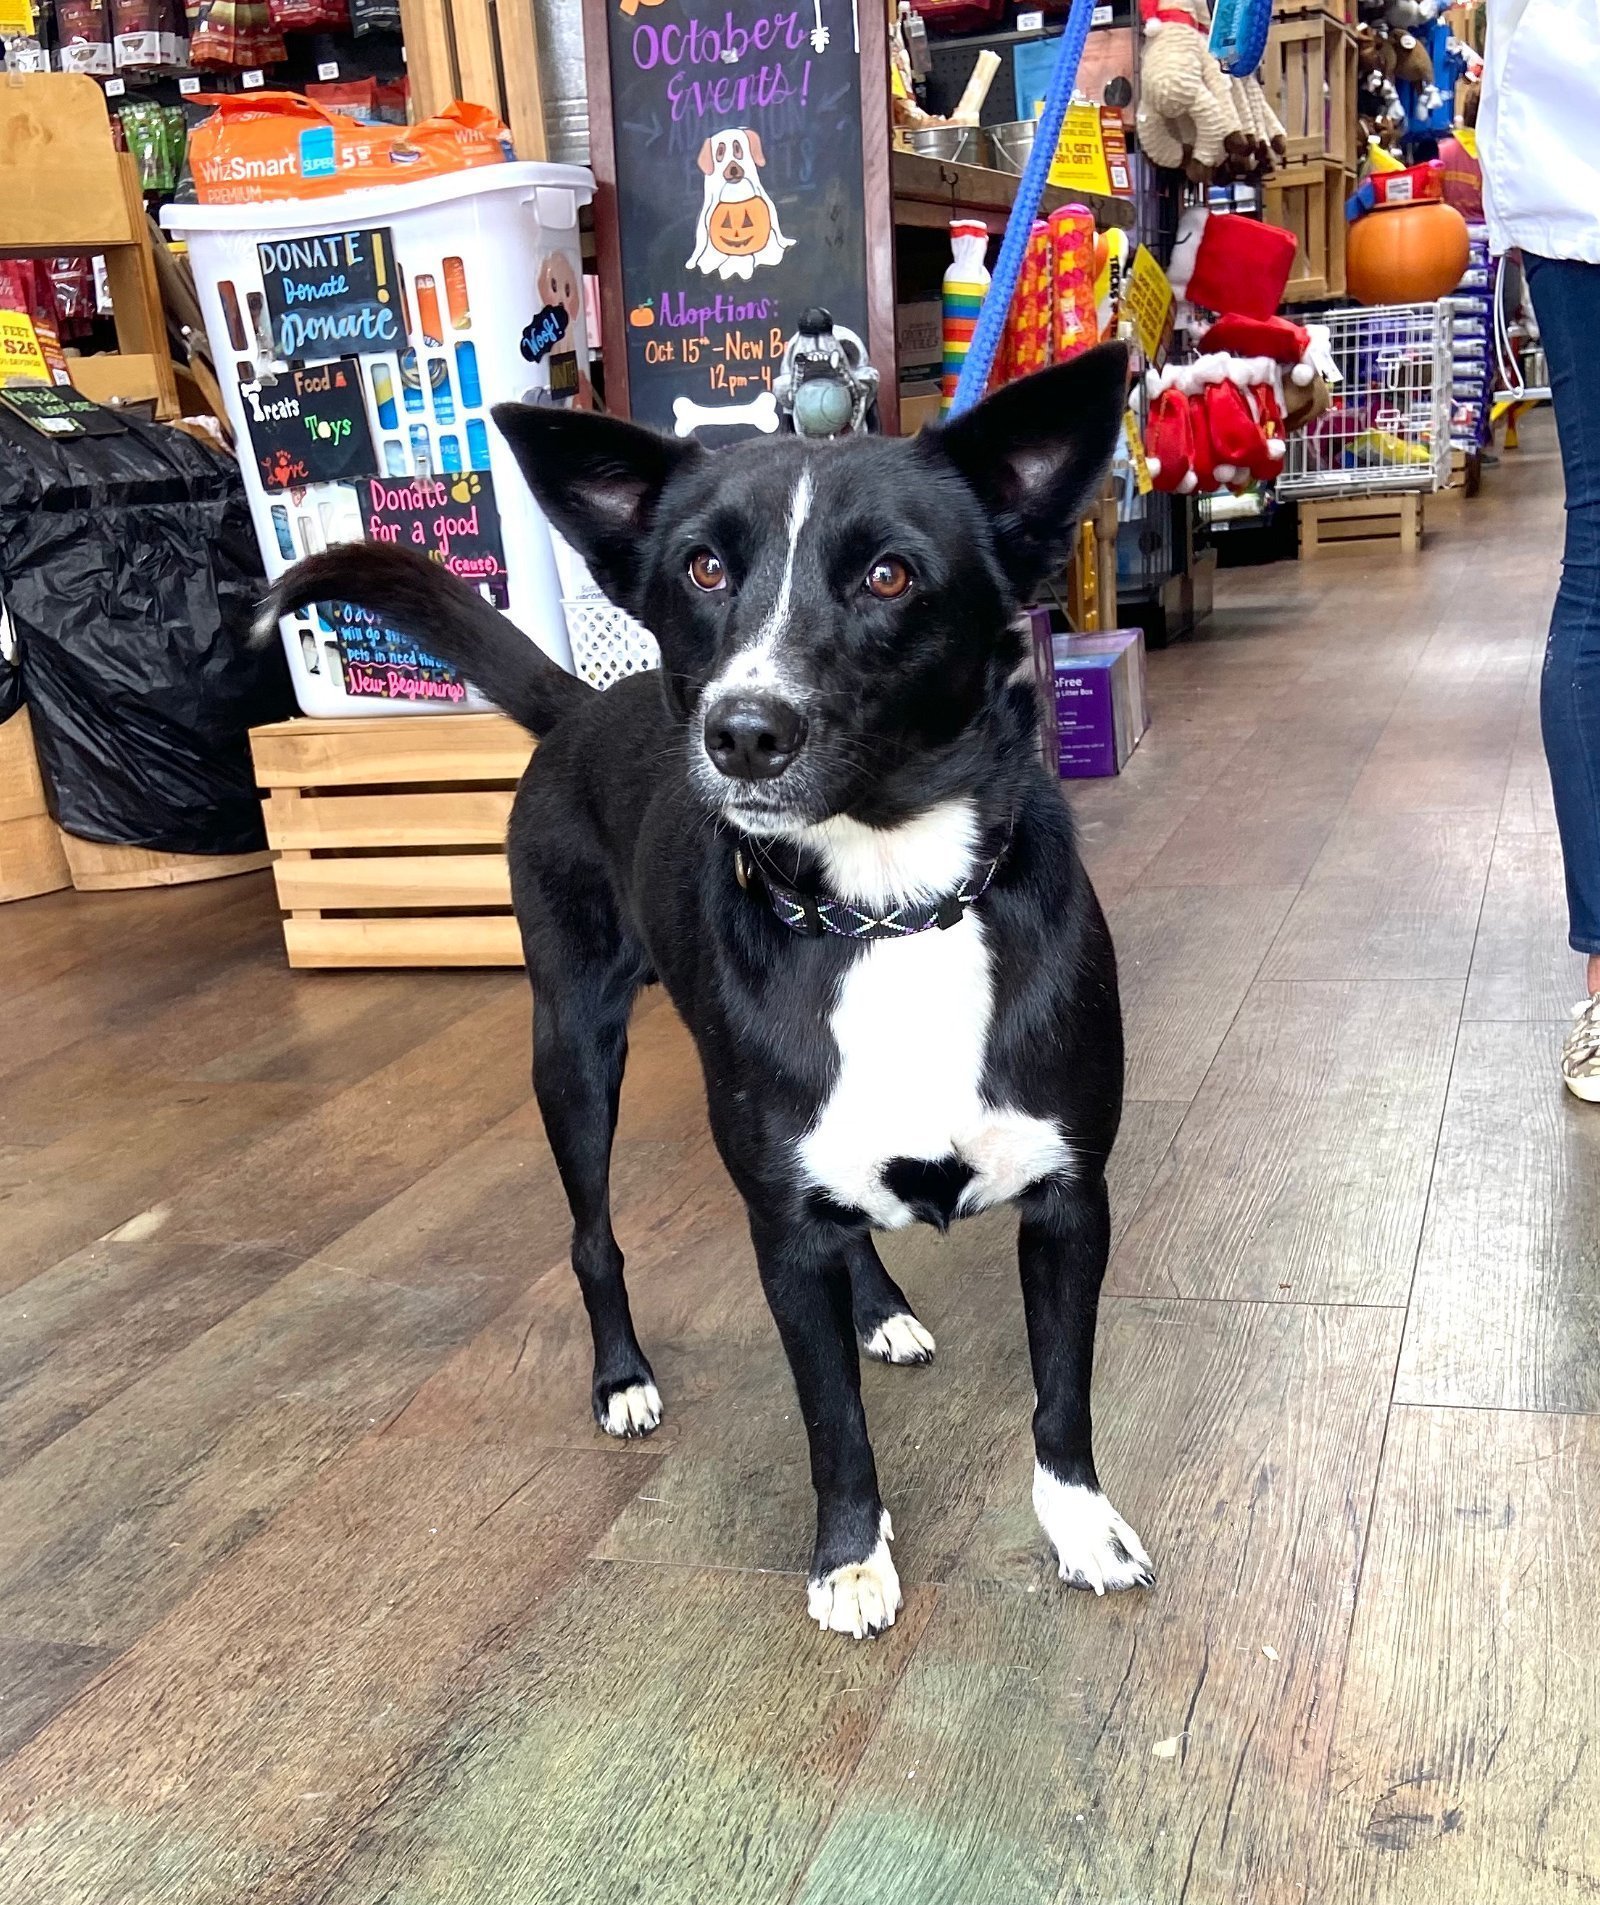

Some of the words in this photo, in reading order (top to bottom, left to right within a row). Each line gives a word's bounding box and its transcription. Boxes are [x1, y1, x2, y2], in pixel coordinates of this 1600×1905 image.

[633, 11, 808, 70] October
[667, 60, 812, 121] Events!
[199, 153, 297, 183] WizSmart
[303, 157, 336, 172] SUPER
[341, 147, 355, 168] 5
[207, 186, 262, 203] PREMIUM
[258, 232, 364, 275] DONATE
[283, 275, 349, 305] Donate
[281, 308, 398, 355] Donate
[659, 291, 779, 336] Adoptions:
[522, 312, 562, 356] Woof!
[293, 366, 331, 396] Food
[248, 392, 300, 422] Treats
[304, 414, 352, 446] Toys
[370, 479, 448, 512] Donate
[370, 515, 401, 544] for
[411, 521, 425, 545] a
[433, 505, 479, 556] good
[366, 627, 380, 647] go
[347, 648, 370, 662] pets
[375, 650, 387, 663] in
[390, 650, 417, 666] need
[349, 667, 386, 694] New
[387, 671, 465, 703] Beginnings
